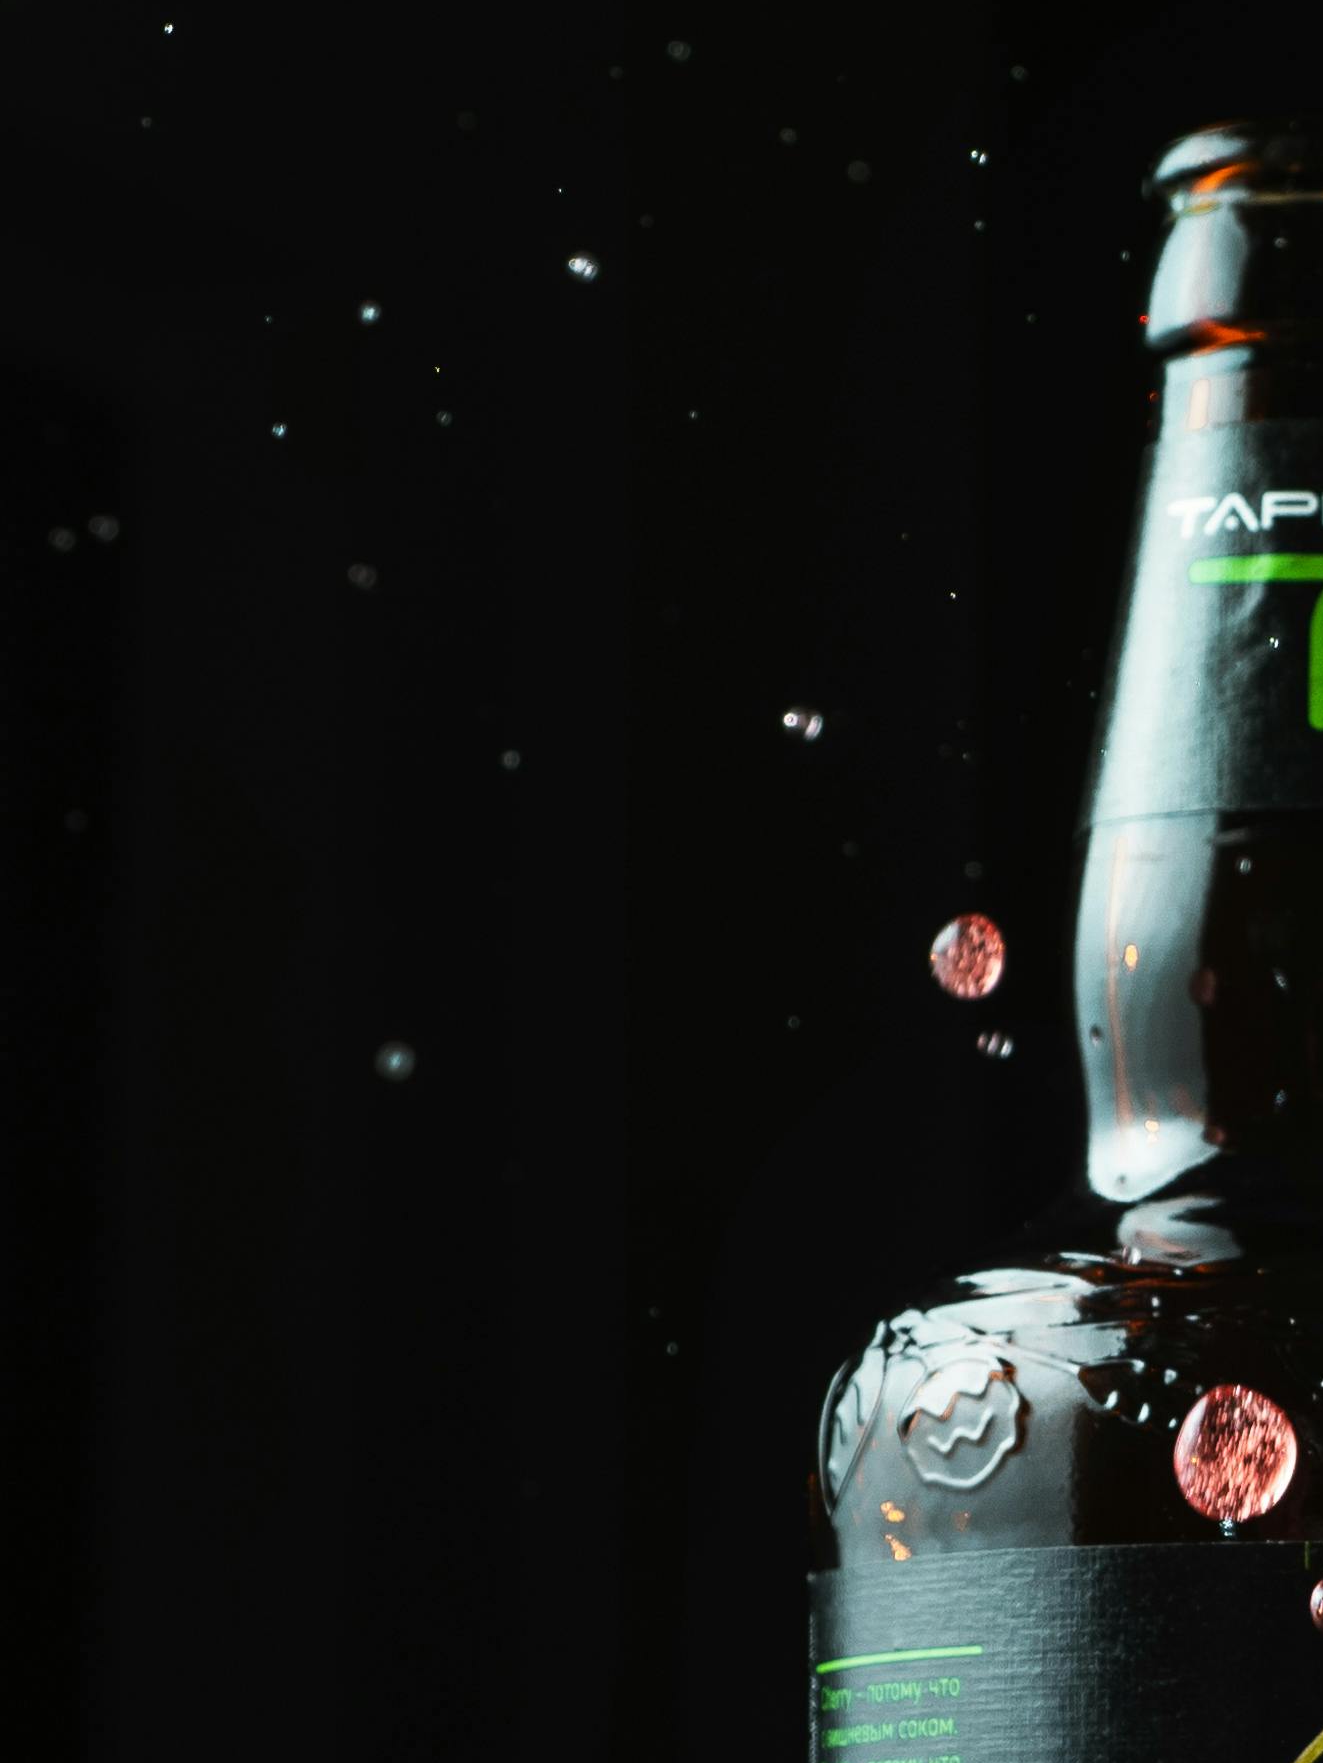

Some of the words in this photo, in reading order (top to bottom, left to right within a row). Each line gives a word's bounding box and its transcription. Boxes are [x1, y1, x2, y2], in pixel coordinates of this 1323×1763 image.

[867, 1681, 922, 1705] потому
[928, 1677, 961, 1697] что
[898, 1717, 958, 1740] соком.
